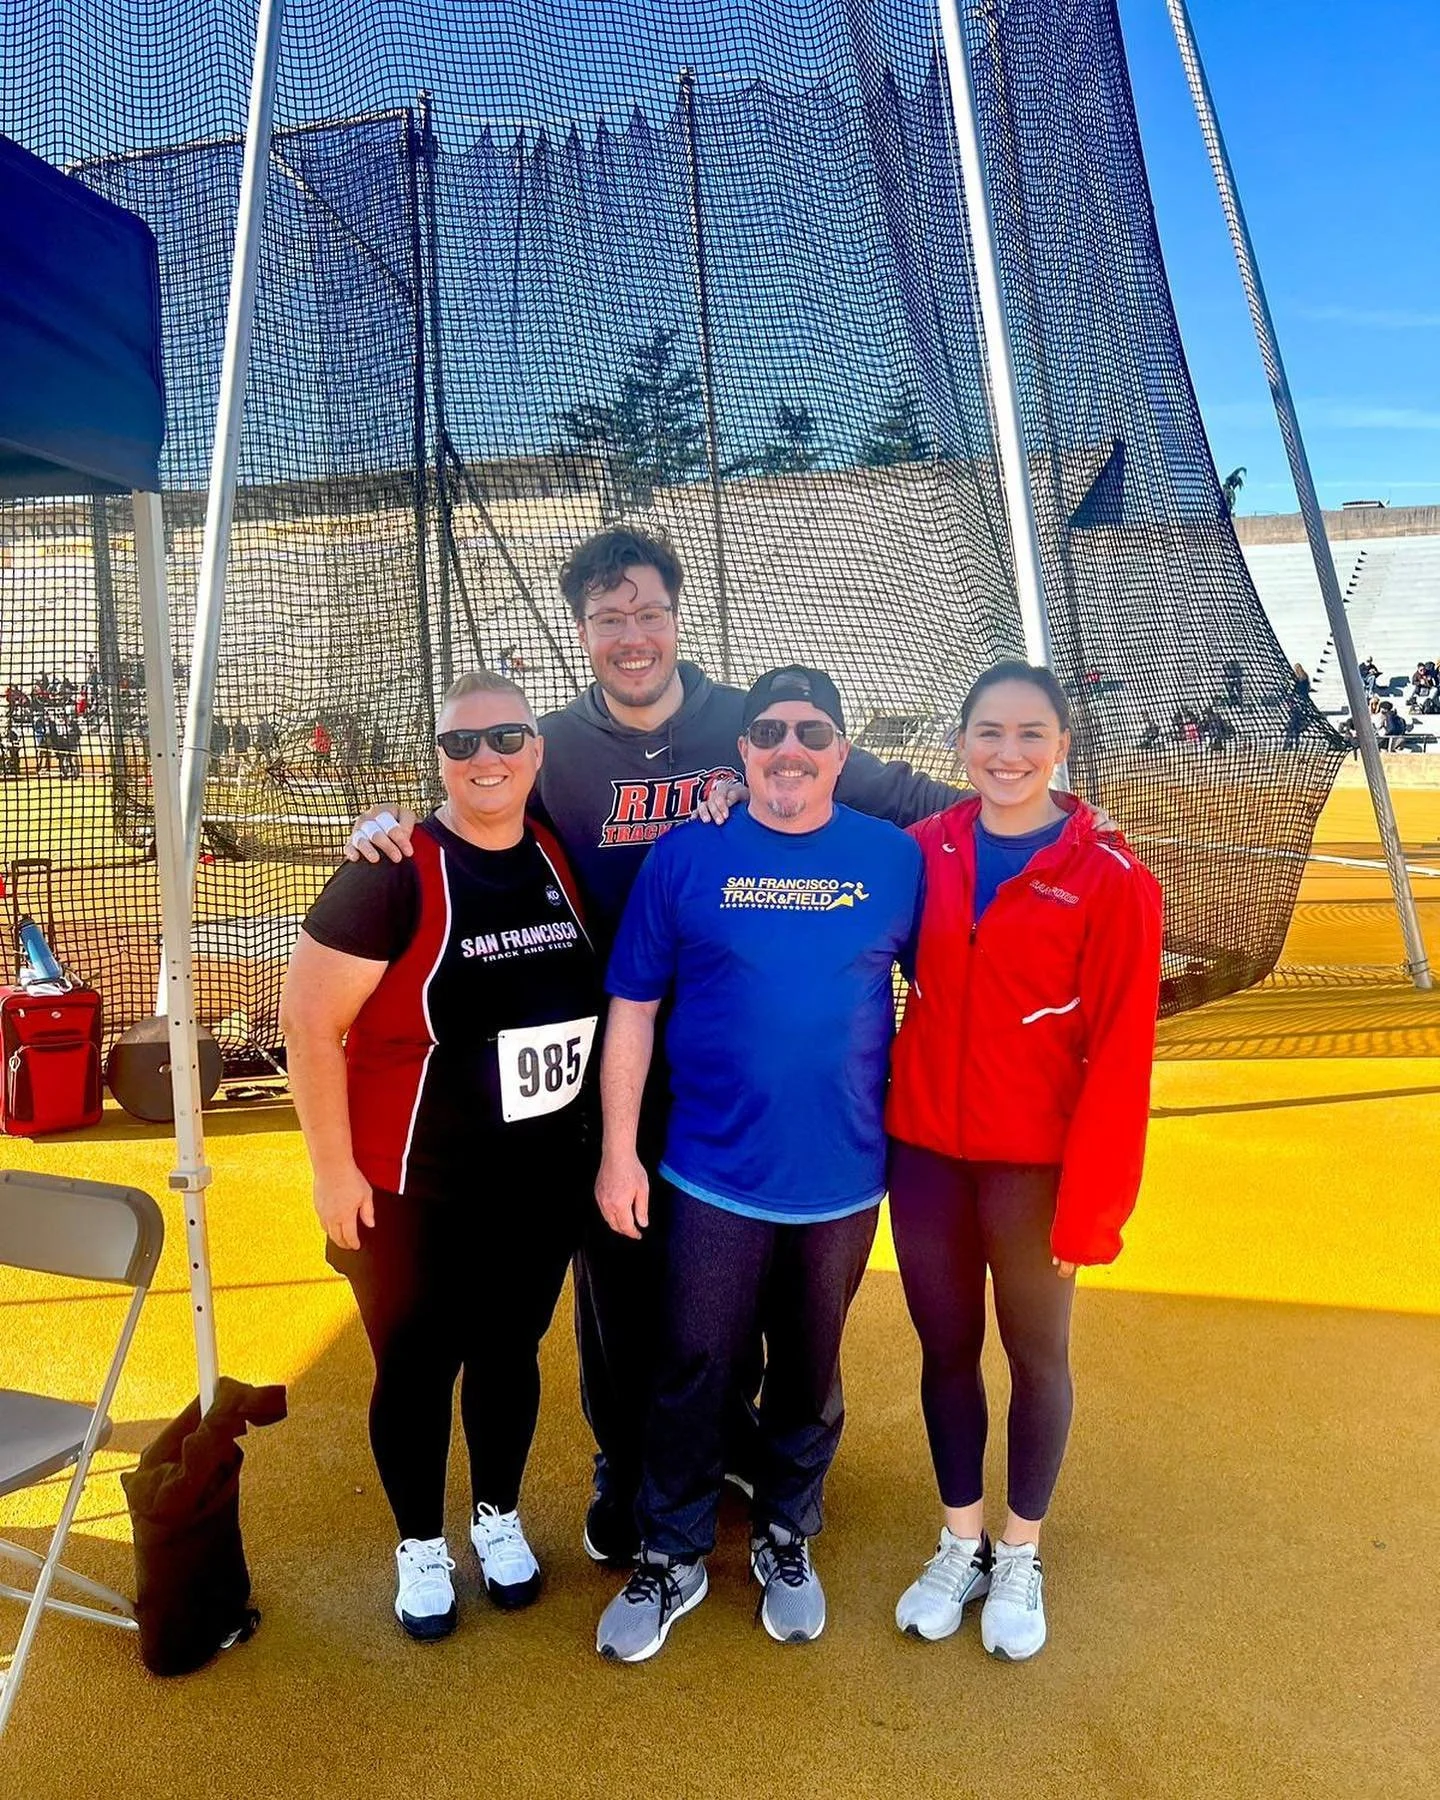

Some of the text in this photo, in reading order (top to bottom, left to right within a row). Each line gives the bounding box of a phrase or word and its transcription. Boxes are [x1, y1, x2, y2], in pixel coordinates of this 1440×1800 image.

[614, 777, 699, 822] RIT
[727, 877, 839, 890] SAN FRANCISCO
[461, 922, 577, 958] SAN FRANCISCO
[482, 941, 573, 962] TRACK AND FIELD
[517, 1036, 581, 1097] 985
